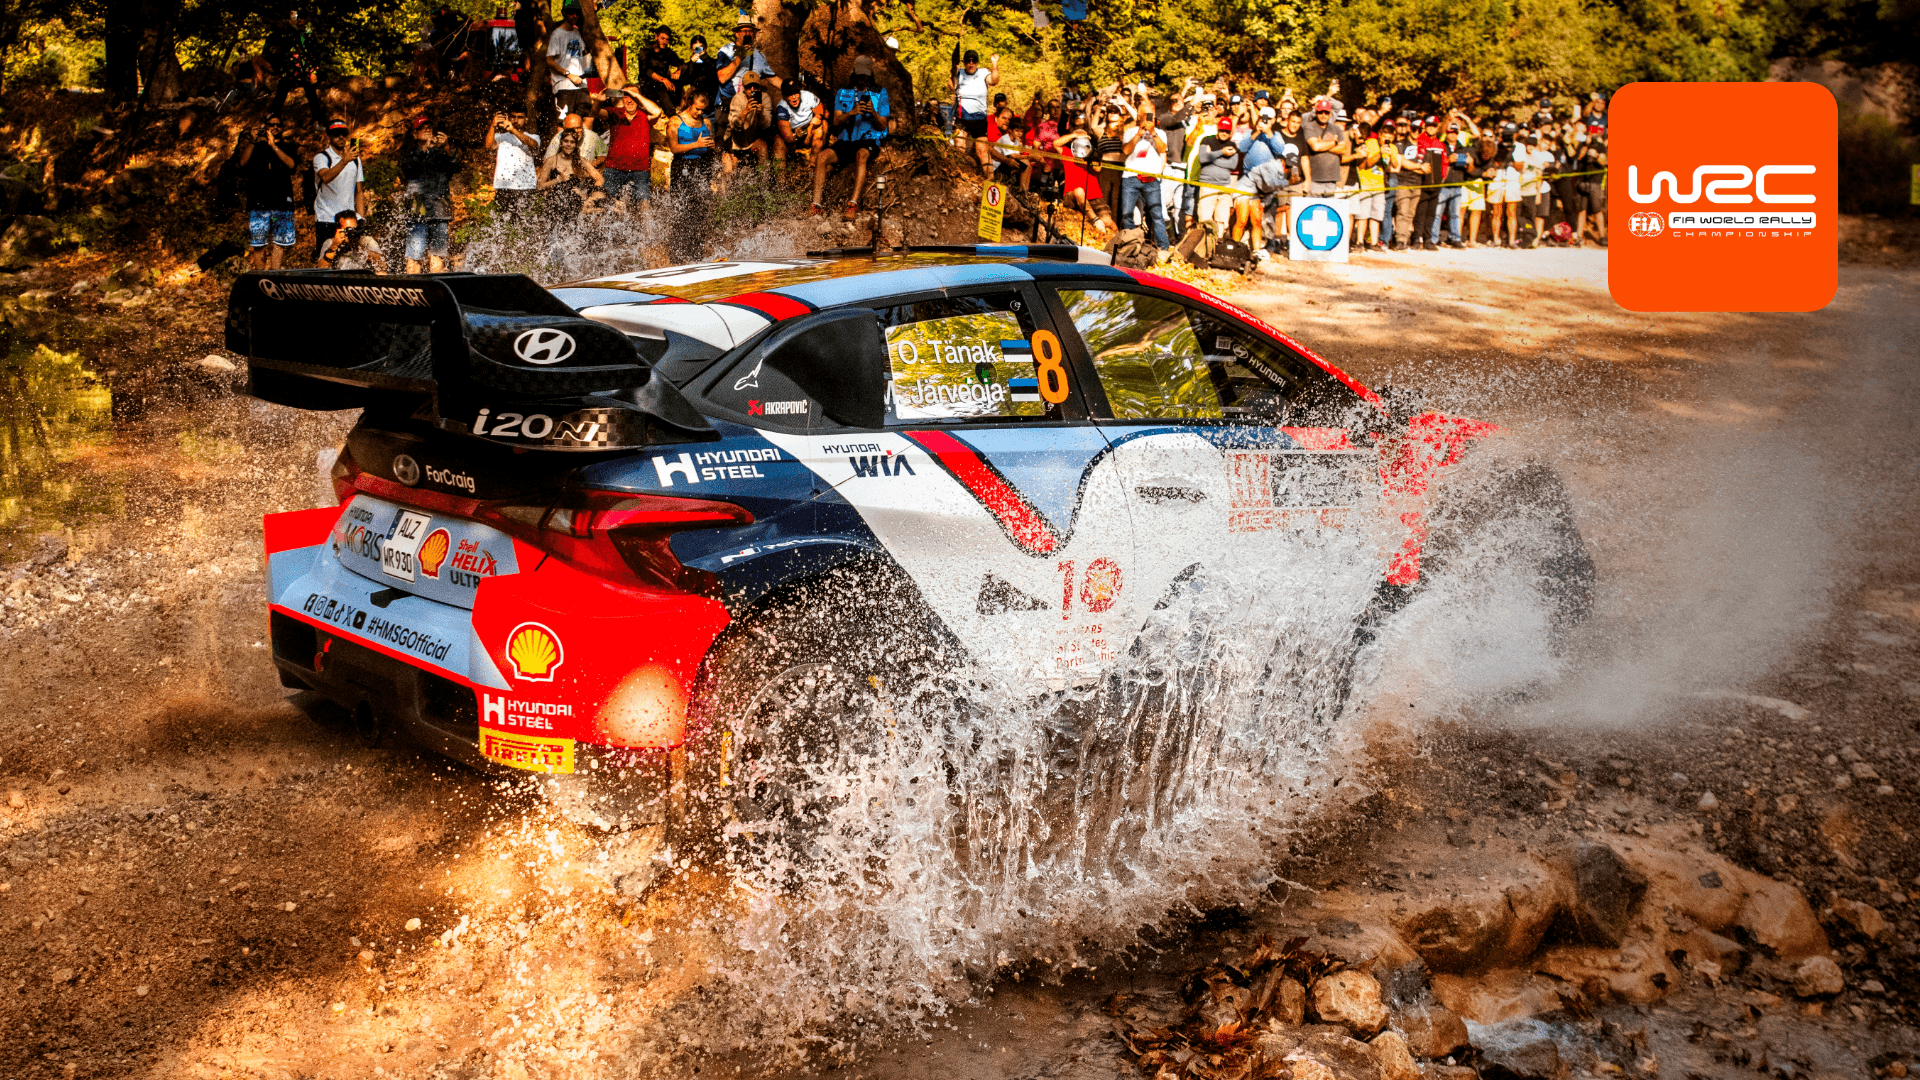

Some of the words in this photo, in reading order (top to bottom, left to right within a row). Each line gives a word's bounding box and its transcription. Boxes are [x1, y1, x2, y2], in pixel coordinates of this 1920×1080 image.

[897, 339, 925, 365] O.
[926, 339, 998, 364] Tänak
[1031, 329, 1069, 404] 8
[1248, 355, 1287, 388] HYUNDAI
[697, 448, 782, 465] HYUNDAI
[822, 443, 882, 454] HYUNDAI
[425, 464, 476, 494] ForCraig
[701, 465, 765, 482] STEEL
[397, 517, 422, 540] ALZ
[344, 522, 385, 562] MOBIS
[458, 538, 480, 553] Shell
[383, 546, 395, 569] WR
[395, 550, 413, 574] 930
[450, 550, 498, 576] HELIX
[450, 569, 481, 590] ULTR
[367, 616, 452, 662] #HMSGOfficial
[507, 699, 573, 717] HYUNDAI
[507, 714, 554, 730] STEEL
[485, 734, 564, 766] PIRELLI
